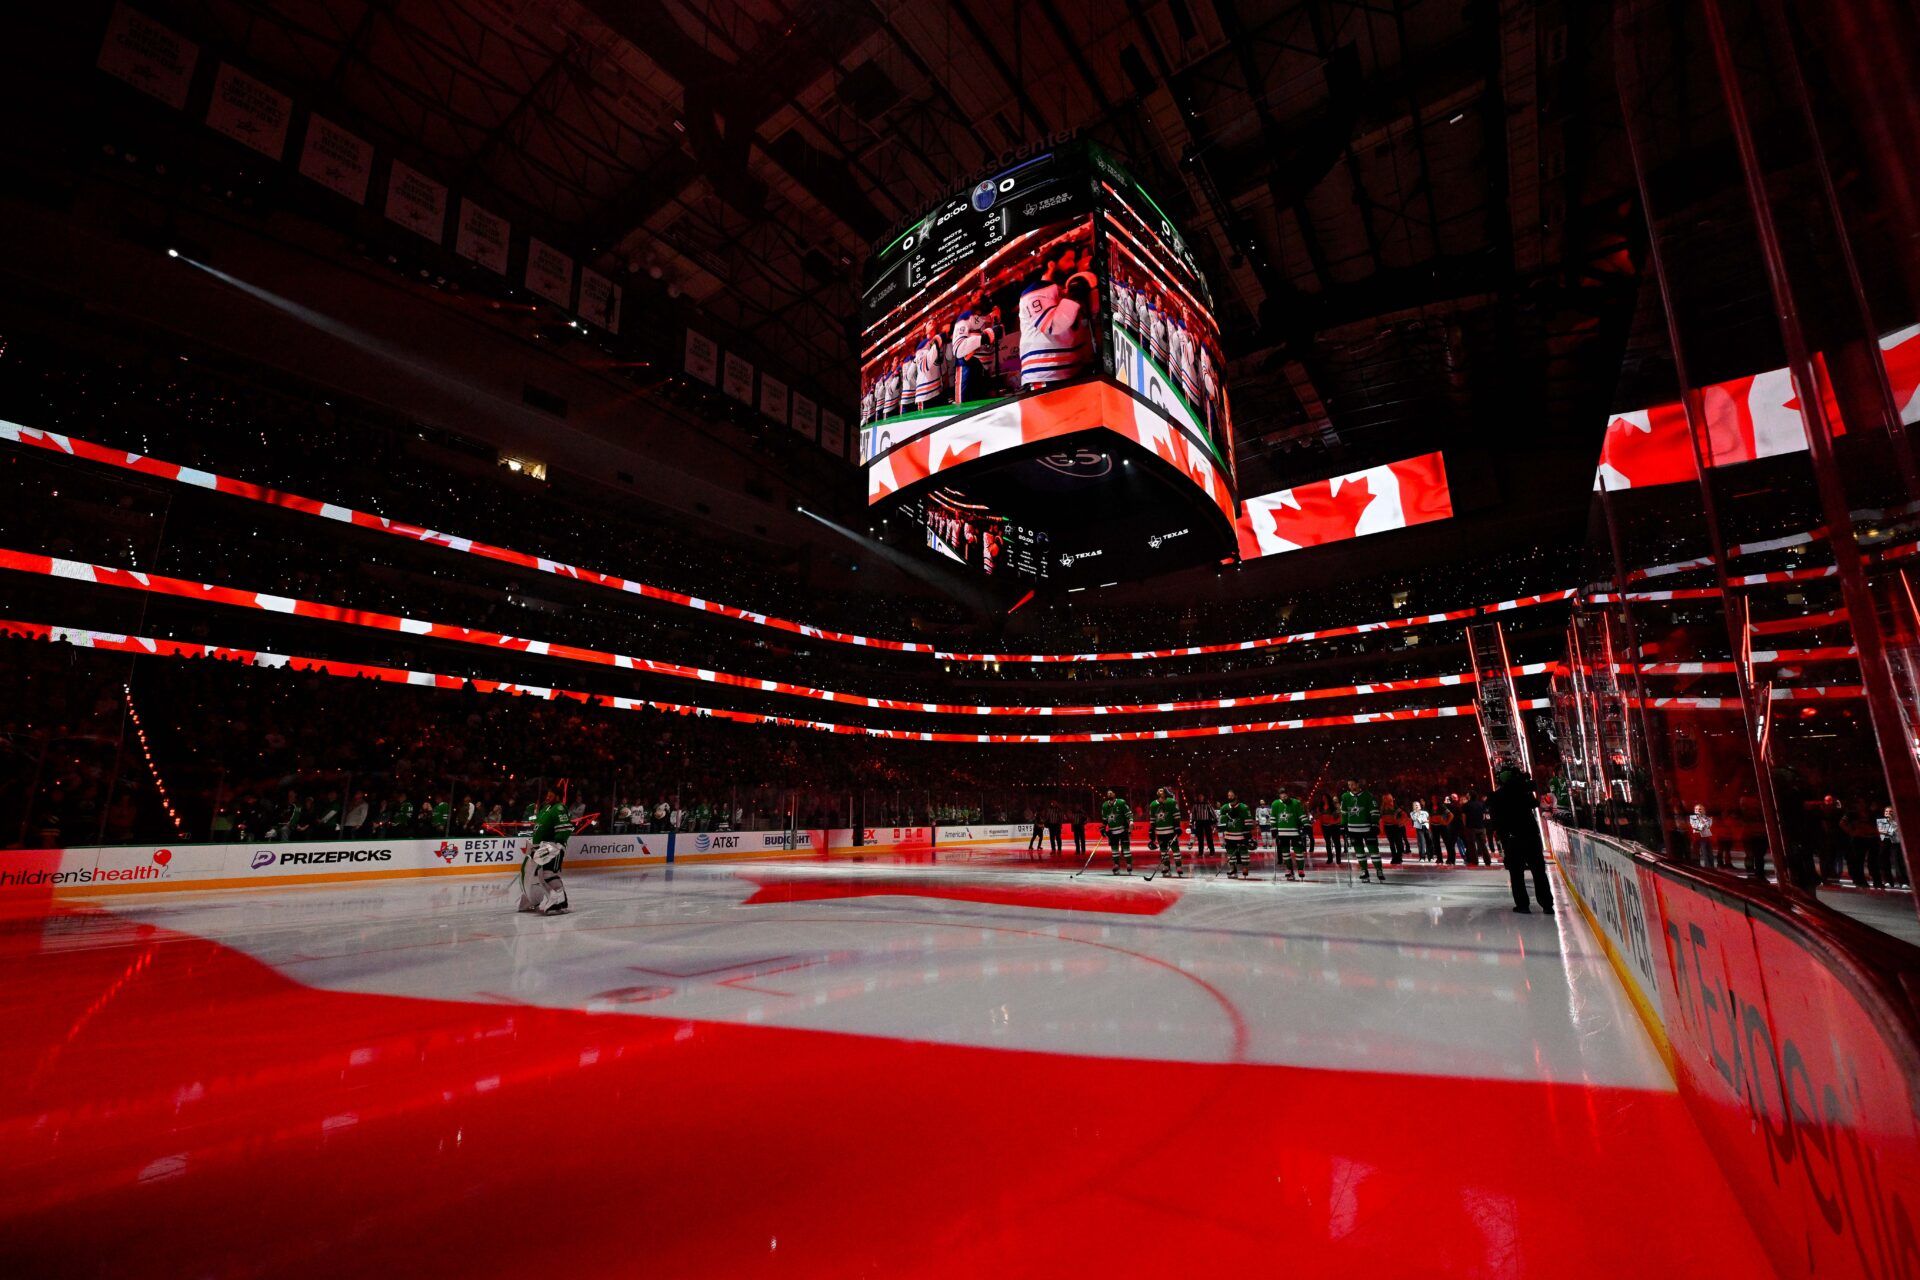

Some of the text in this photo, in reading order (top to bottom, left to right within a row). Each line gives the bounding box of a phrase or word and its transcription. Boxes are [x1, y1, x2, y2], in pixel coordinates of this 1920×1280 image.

[999, 178, 1015, 192] 0
[937, 203, 968, 226] 20:00
[902, 236, 914, 251] 0
[1162, 528, 1189, 540] TEXAS
[1074, 549, 1103, 560] TEXAS
[765, 836, 784, 845] BUD
[944, 830, 967, 839] American
[464, 839, 516, 850] BEST IN
[712, 836, 740, 849] AT&T
[580, 843, 635, 855] American
[279, 849, 392, 865] PRIZEPICKS
[465, 850, 515, 863] TEXAS
